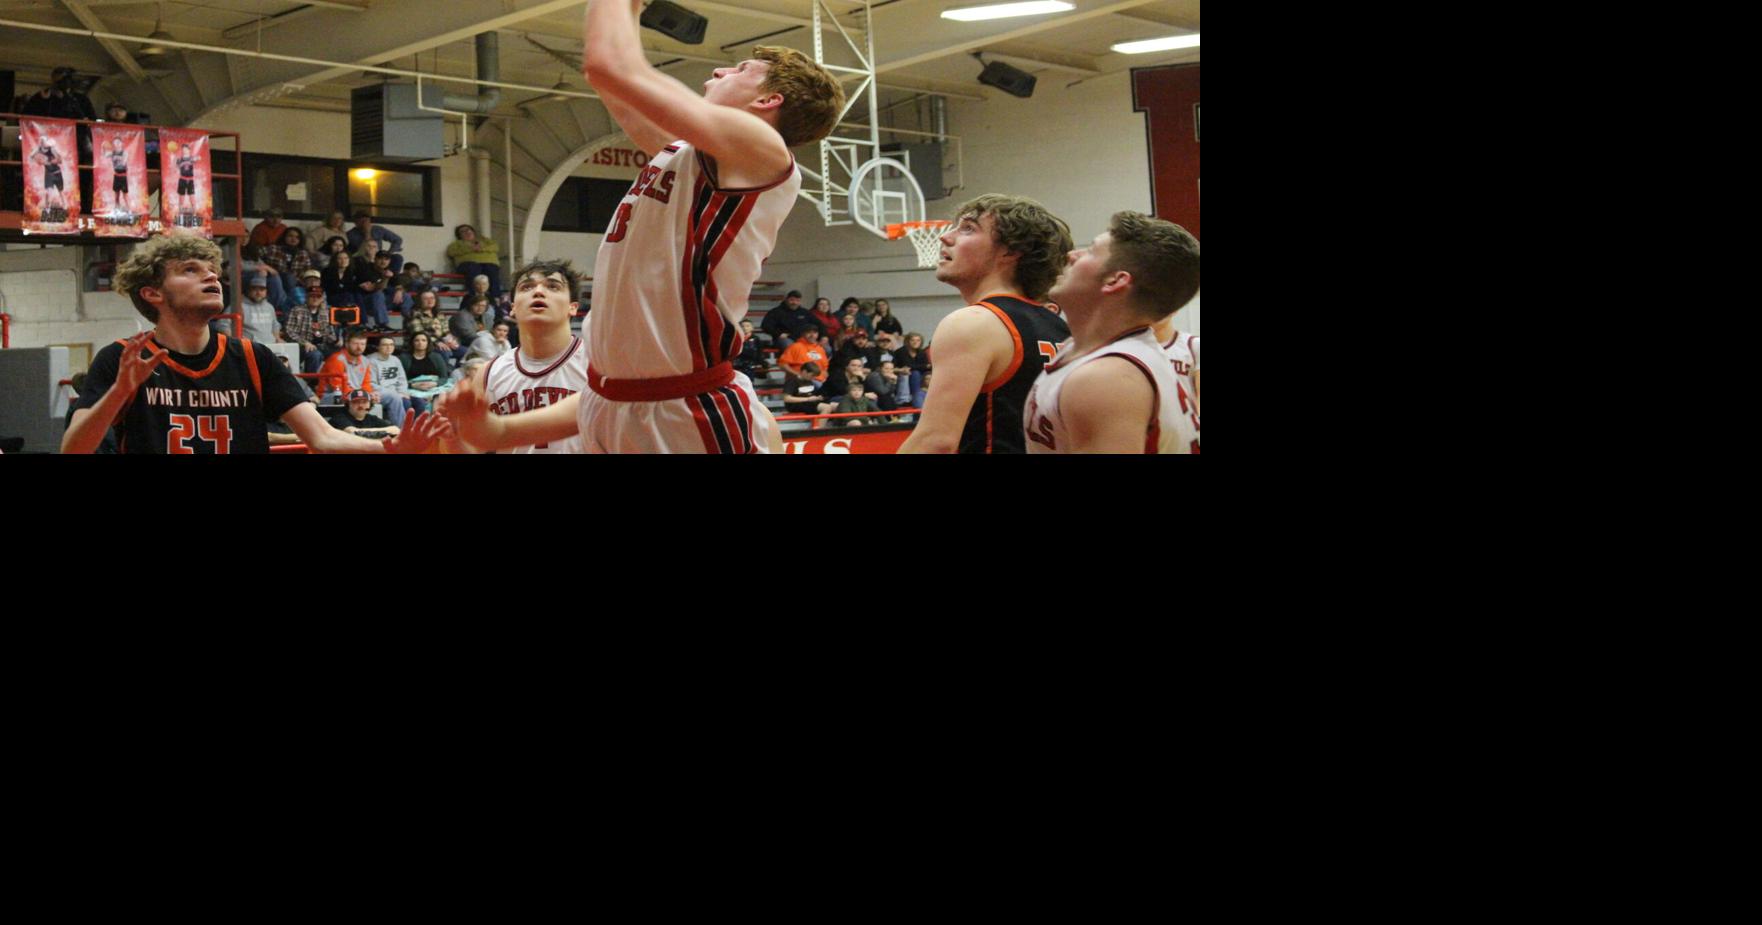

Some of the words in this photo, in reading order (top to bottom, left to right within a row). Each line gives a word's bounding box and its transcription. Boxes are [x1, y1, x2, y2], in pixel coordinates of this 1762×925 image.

[145, 386, 183, 407] WIRT
[188, 388, 250, 408] COUNTY
[166, 413, 233, 454] 24
